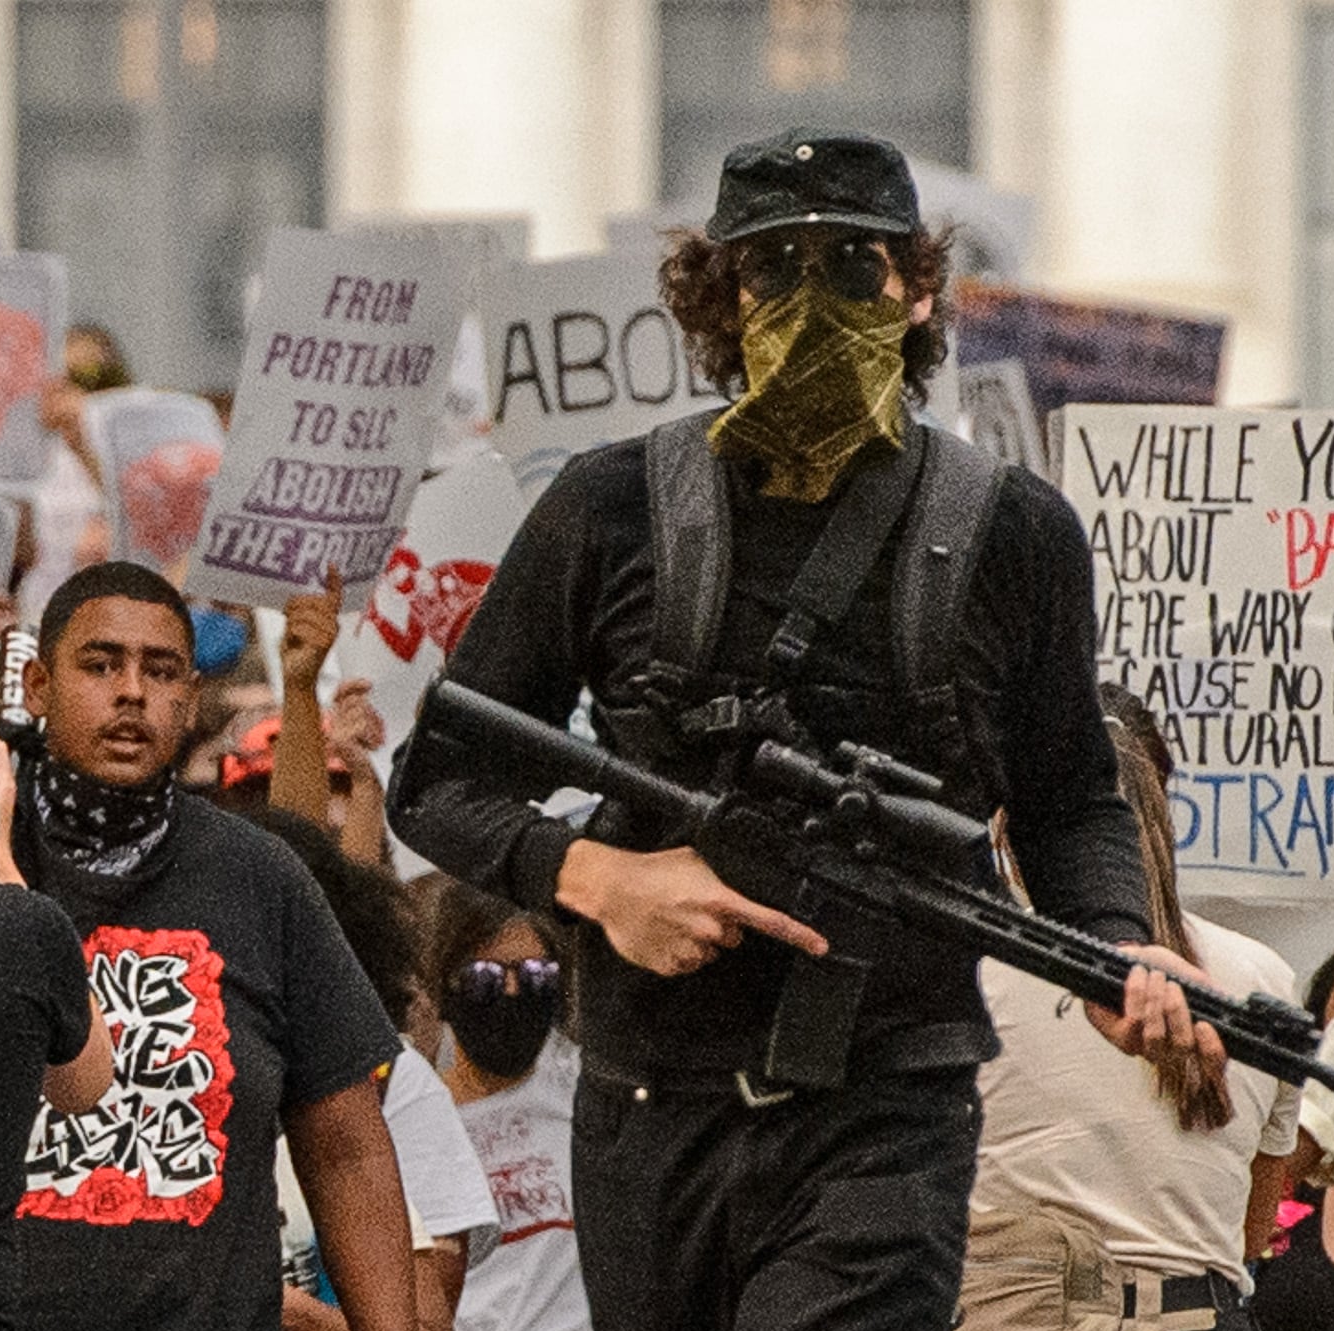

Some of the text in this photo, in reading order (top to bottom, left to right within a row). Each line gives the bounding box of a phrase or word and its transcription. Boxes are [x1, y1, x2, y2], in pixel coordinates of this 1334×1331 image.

[323, 275, 417, 324] FROM
[263, 332, 435, 387] PORTLAND
[291, 400, 337, 446] TO
[249, 462, 395, 517] ABOLISH
[1078, 422, 1260, 504] WHILE
[208, 518, 291, 573] THE
[1091, 508, 1232, 592] ABOUT
[1209, 594, 1313, 662] WARY
[1099, 661, 1255, 712] CAUSE
[1269, 662, 1322, 711] NO
